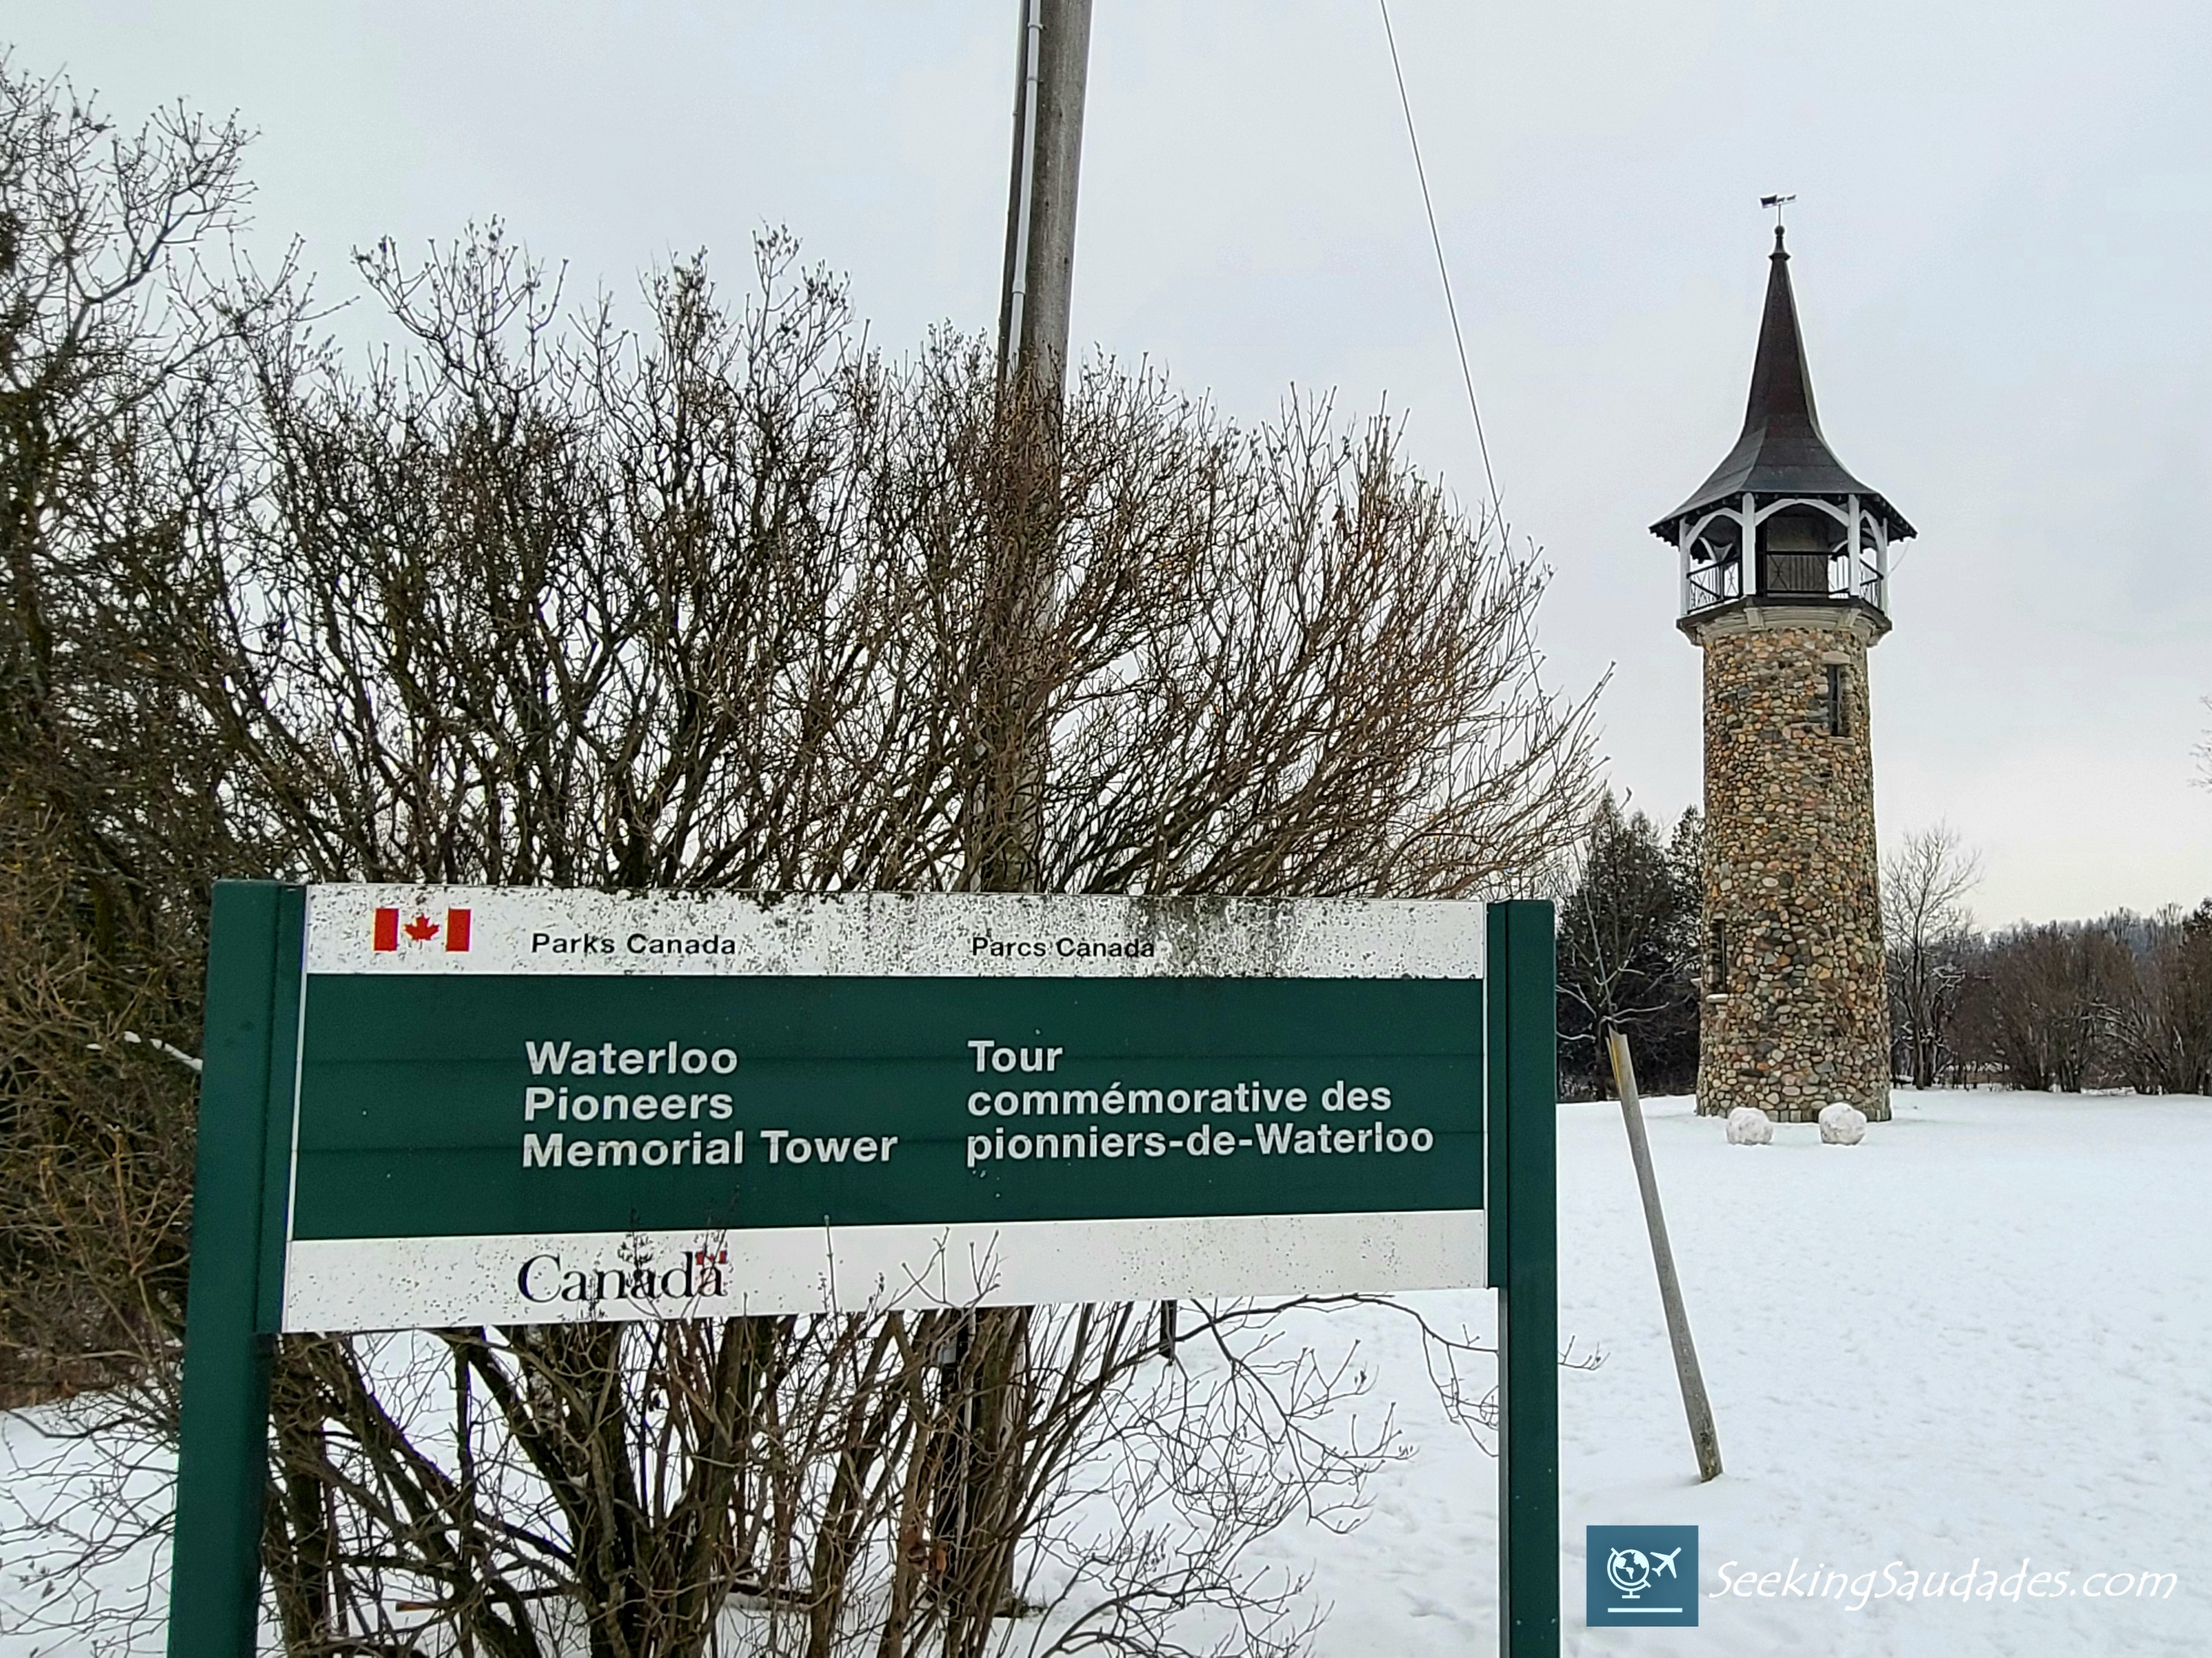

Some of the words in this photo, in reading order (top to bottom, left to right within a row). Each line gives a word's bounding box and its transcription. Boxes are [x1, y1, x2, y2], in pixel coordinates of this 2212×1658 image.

[530, 933, 616, 955] Parks
[627, 933, 736, 956] Canada
[971, 936, 1047, 958] Parcs
[1056, 936, 1155, 958] Canada
[524, 1040, 739, 1076] Waterloo
[967, 1040, 1063, 1073] Tour
[524, 1085, 733, 1122] Pioneers
[967, 1080, 1309, 1117] commémorative
[1321, 1080, 1392, 1112] des
[521, 1129, 744, 1169] Memorial
[760, 1129, 899, 1164] Tower
[966, 1121, 1435, 1168] pionniers-de-Waterloo
[517, 1252, 725, 1303] Canada
